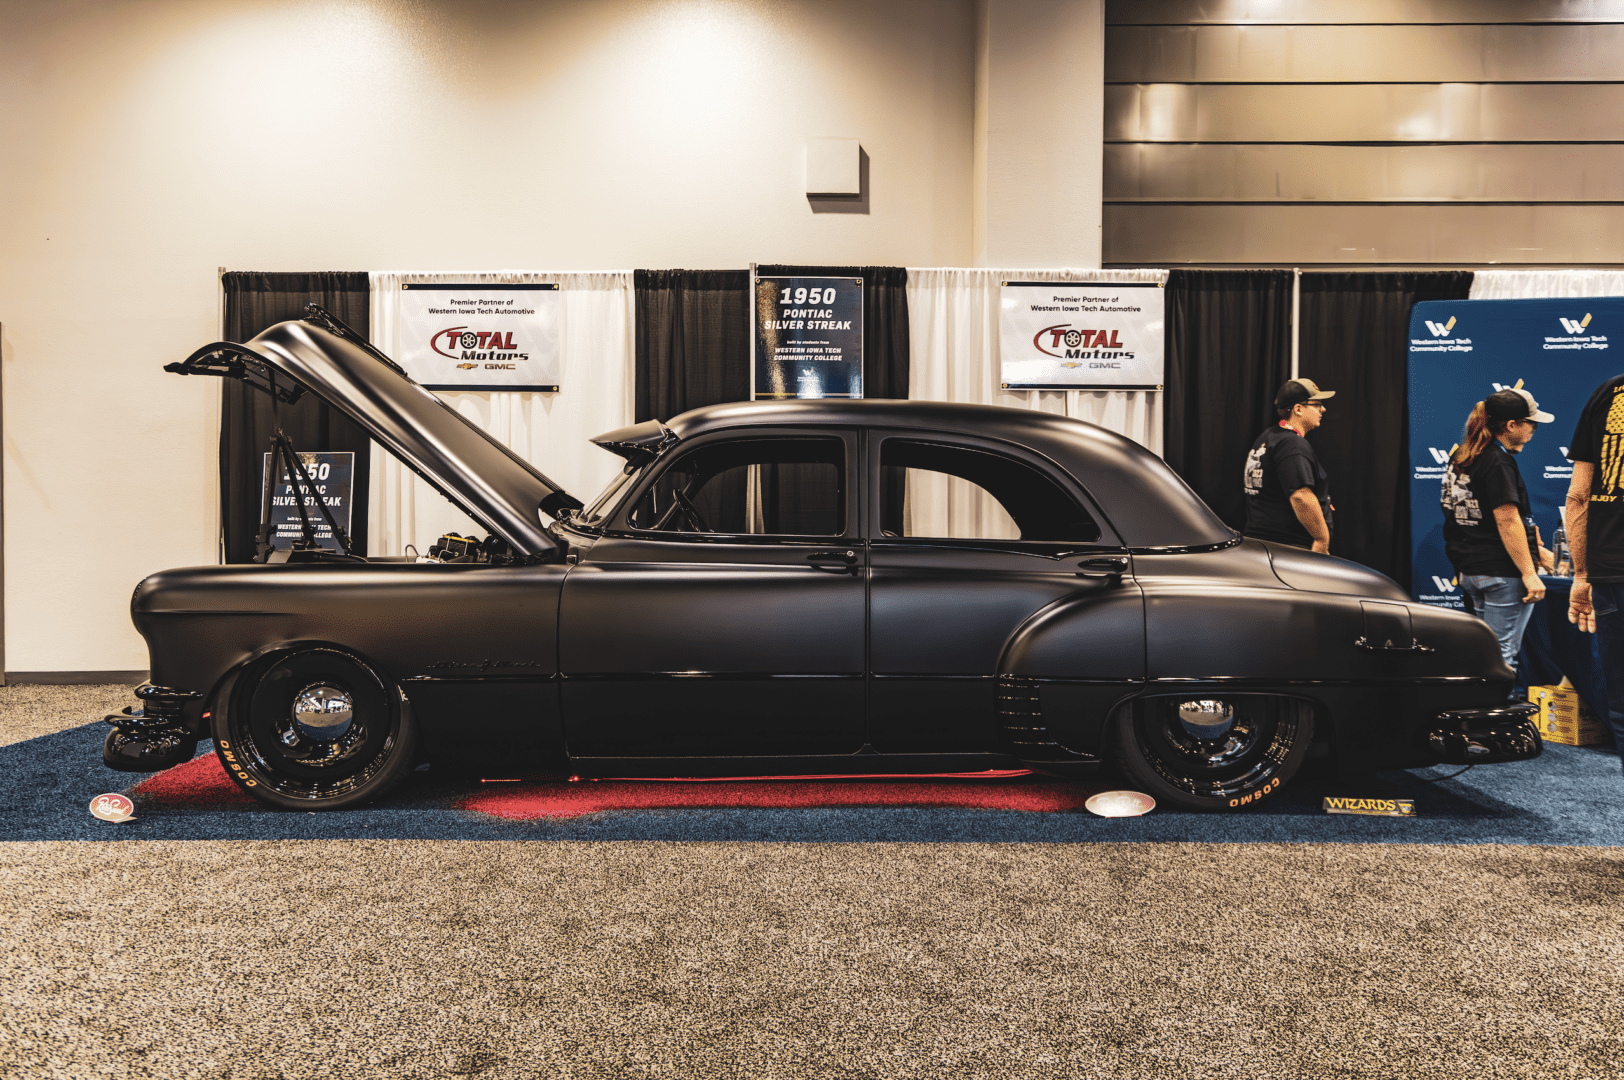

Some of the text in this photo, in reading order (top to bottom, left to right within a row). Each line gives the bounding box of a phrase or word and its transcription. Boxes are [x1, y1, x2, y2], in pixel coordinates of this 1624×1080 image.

[780, 287, 836, 305] 1950
[1053, 295, 1081, 303] Premier
[1082, 295, 1110, 303] Partner
[428, 307, 458, 315] Western
[458, 307, 476, 315] Iowa
[495, 307, 535, 315] Automotive
[783, 309, 833, 318] PONTIAC
[1030, 304, 1060, 312] Western
[1062, 304, 1080, 312] Iowa
[1099, 305, 1141, 313] Automotive
[764, 320, 851, 330] SILVER STREAK
[446, 331, 518, 350] TOTAL
[1050, 329, 1123, 349] TOTAL
[1409, 344, 1473, 353] Community College
[1582, 342, 1609, 350] College
[460, 350, 529, 361] Motors
[1064, 349, 1135, 359] Motors
[272, 496, 342, 506] SILVE STEAK
[220, 740, 257, 787] COSMO
[1229, 777, 1280, 807] COSMO
[1325, 796, 1396, 811] WIZARDS
